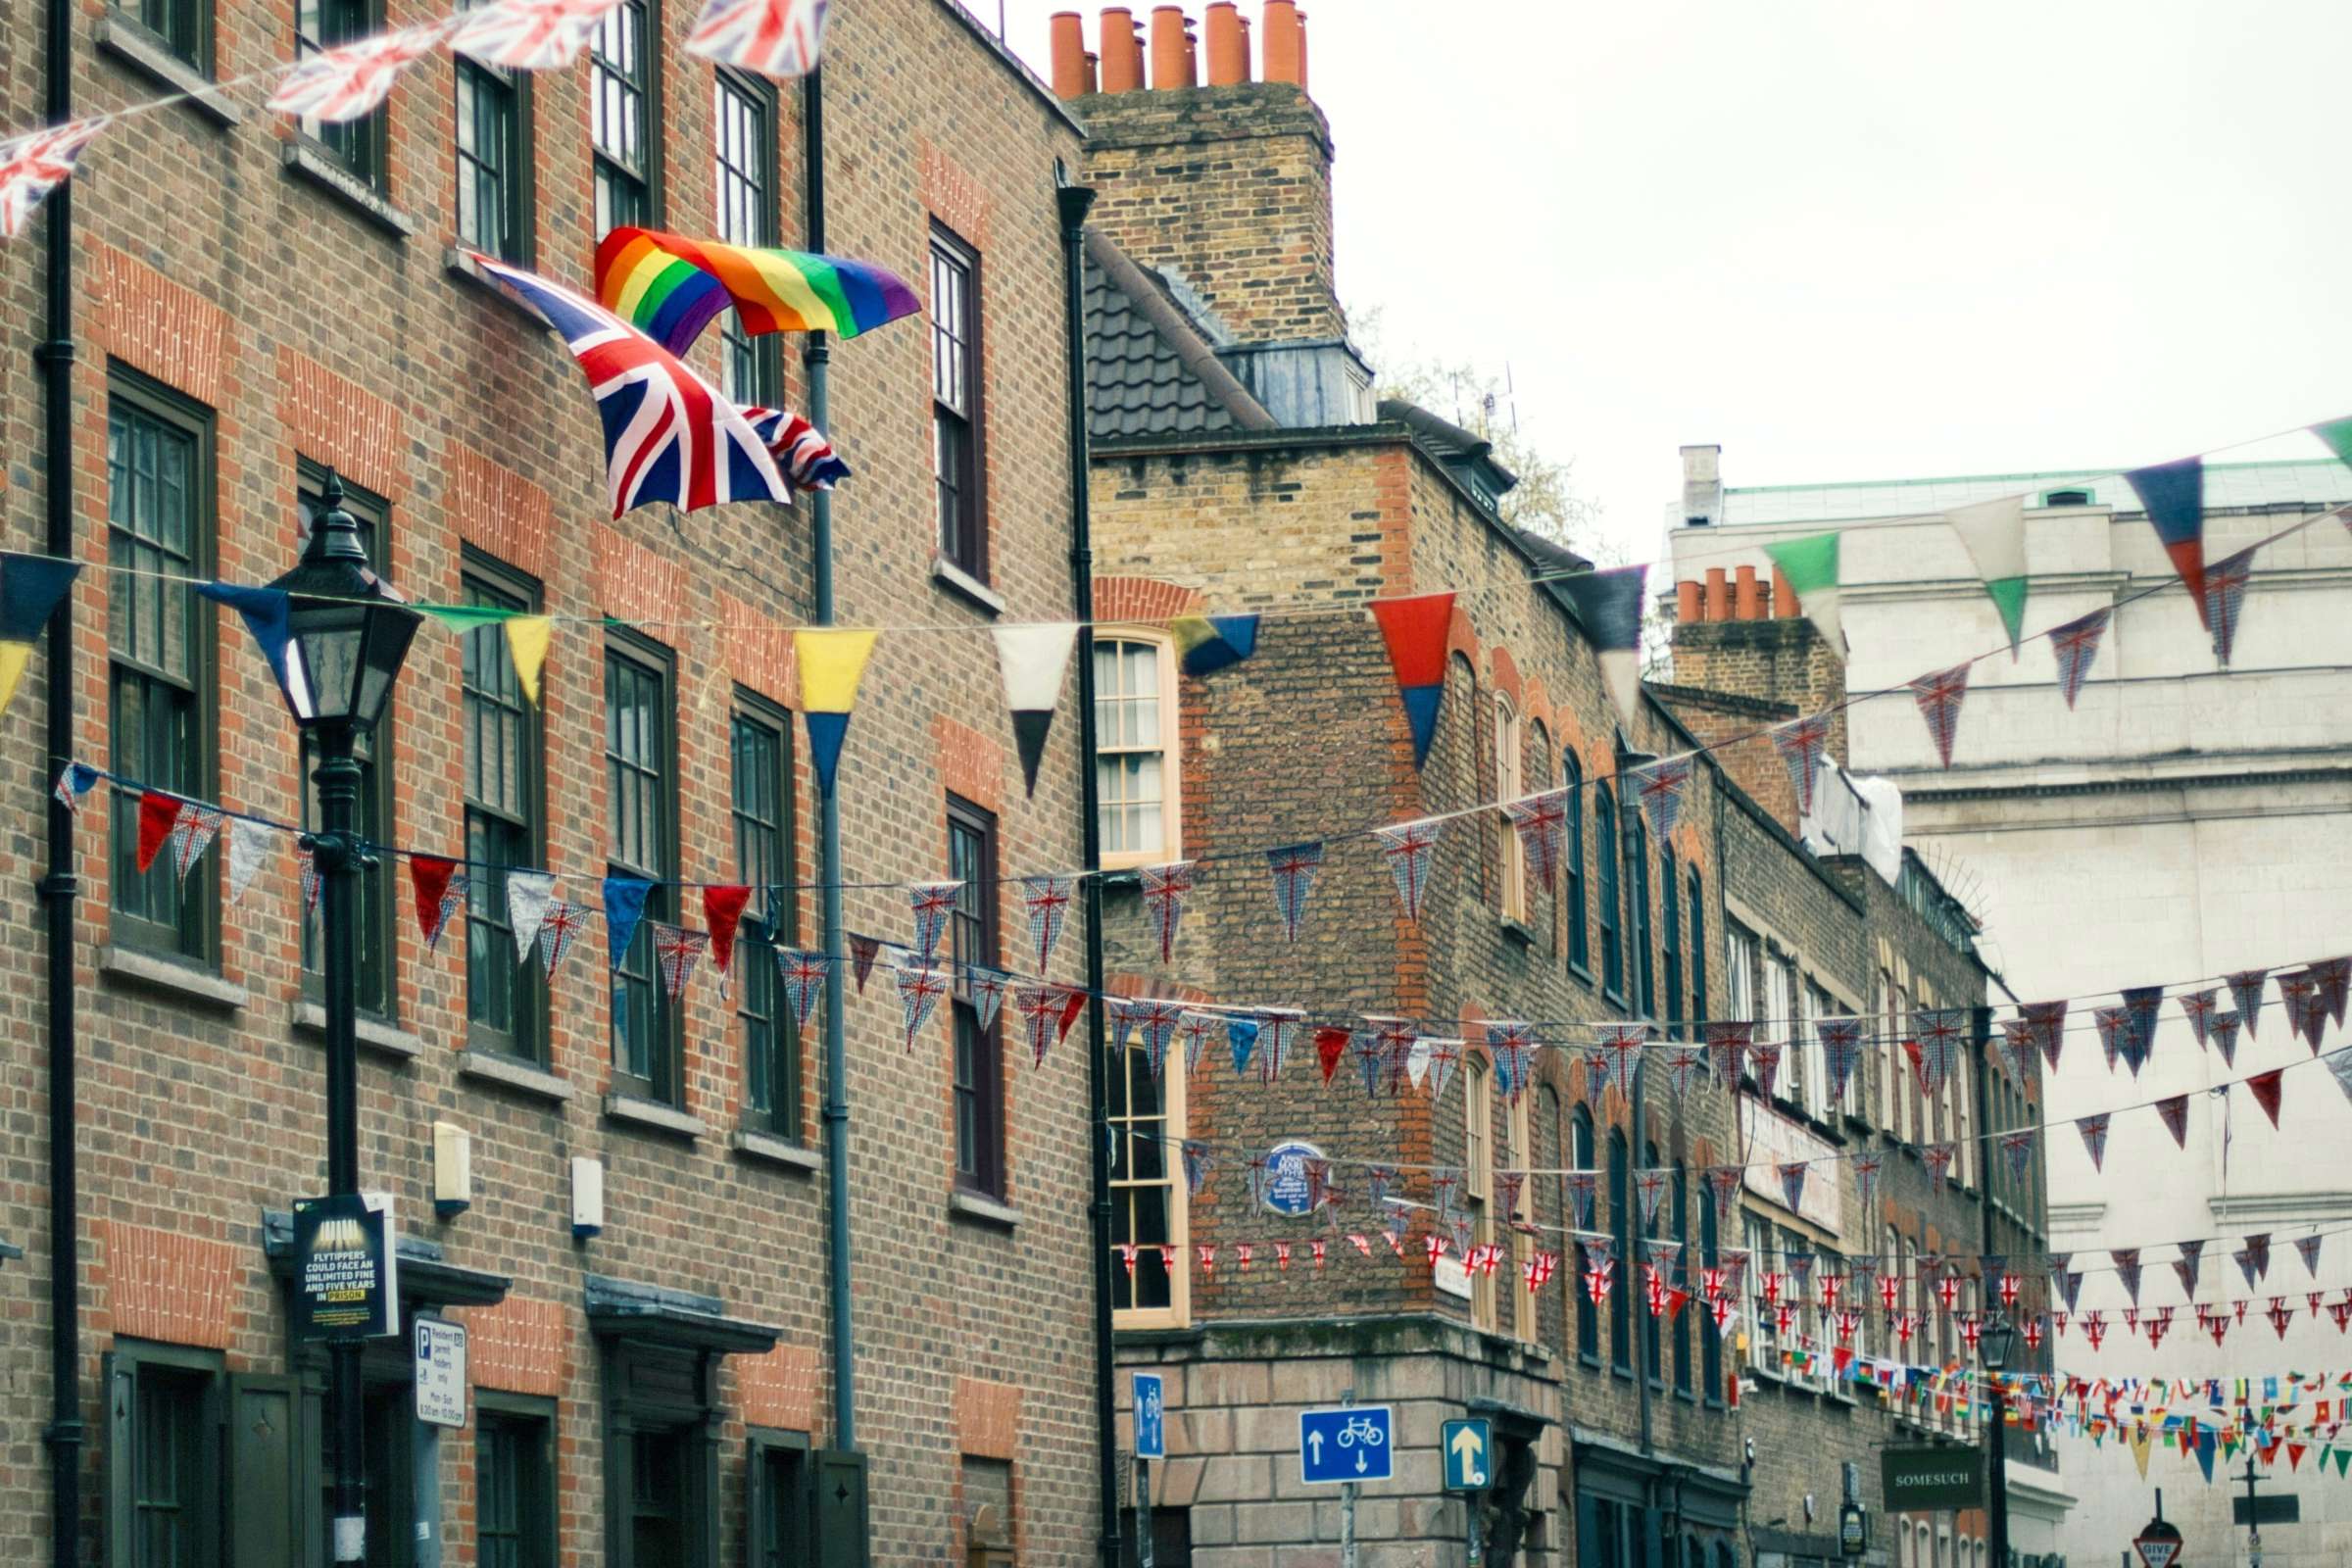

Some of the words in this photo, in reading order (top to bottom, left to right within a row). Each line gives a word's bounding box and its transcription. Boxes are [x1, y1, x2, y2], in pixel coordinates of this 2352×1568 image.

[314, 1250, 366, 1262] FLYTIPPERS
[306, 1262, 335, 1272] COULD
[337, 1261, 359, 1270] FACE
[361, 1260, 373, 1269] AN
[306, 1271, 353, 1283] UNLIMITED
[355, 1270, 375, 1279] FINE
[306, 1283, 324, 1293] AND
[325, 1282, 345, 1291] FIVE
[346, 1280, 375, 1290] YEARS
[317, 1293, 326, 1301] IN
[1895, 1472, 1969, 1488] SOMESUCH
[2143, 1544, 2172, 1553] GIVE
